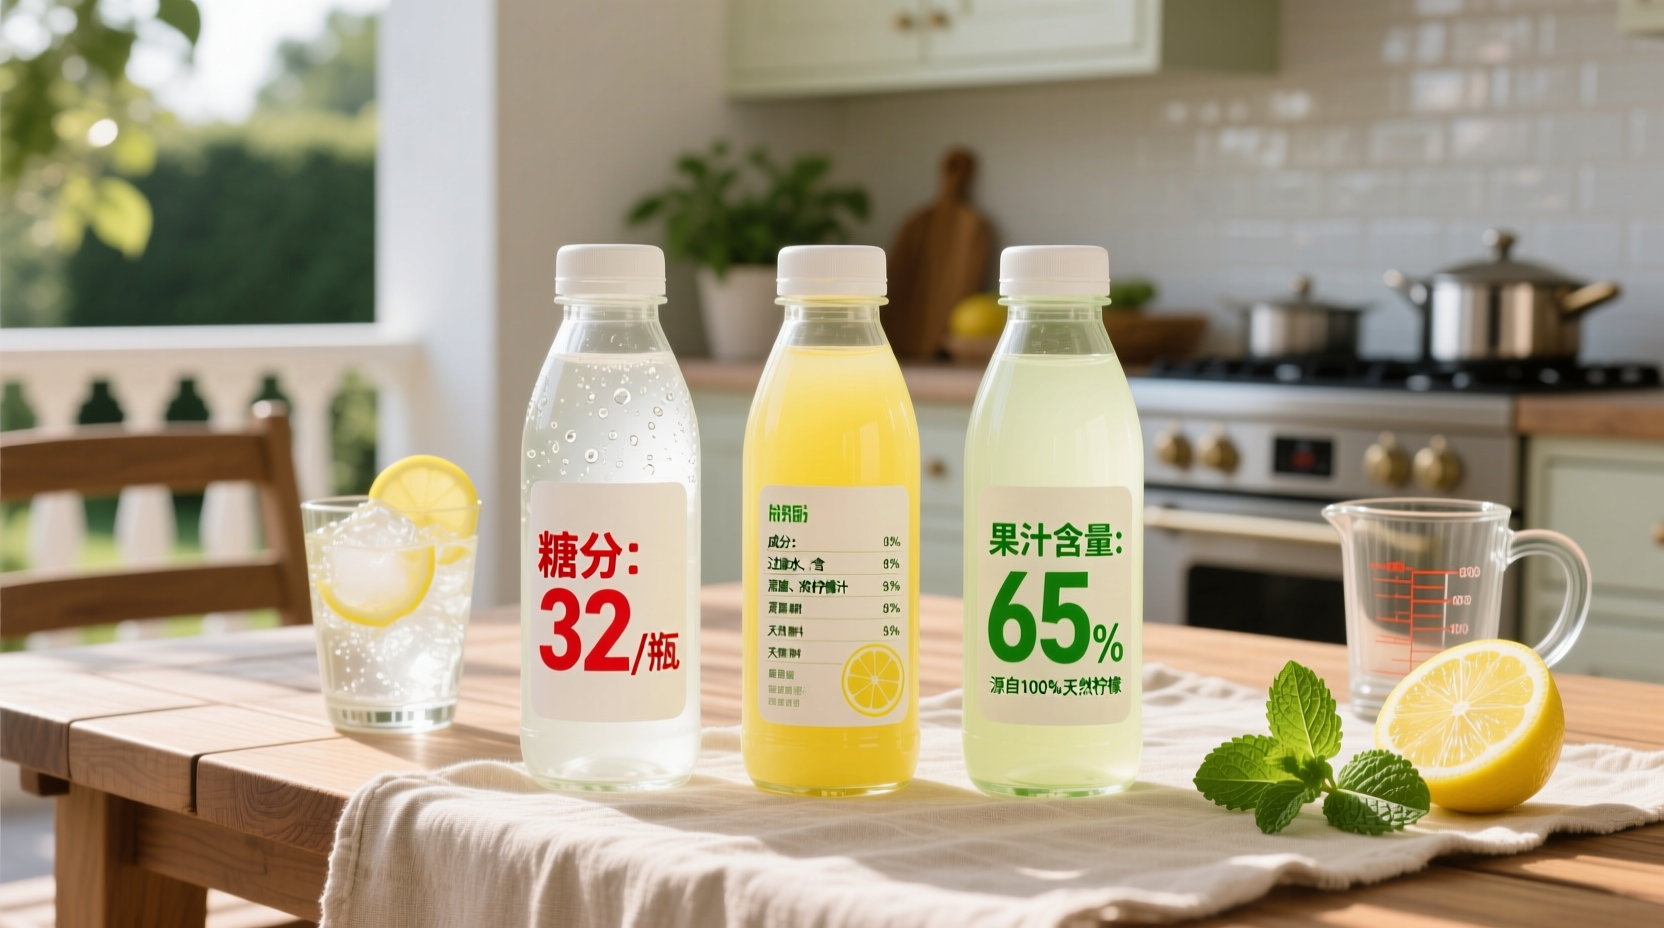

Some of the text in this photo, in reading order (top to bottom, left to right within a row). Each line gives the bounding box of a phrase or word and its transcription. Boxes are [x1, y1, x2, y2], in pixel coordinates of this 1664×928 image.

[538, 530, 638, 579] 糖分：
[989, 522, 1122, 558] 果汁含量：
[988, 571, 1123, 664] 65%
